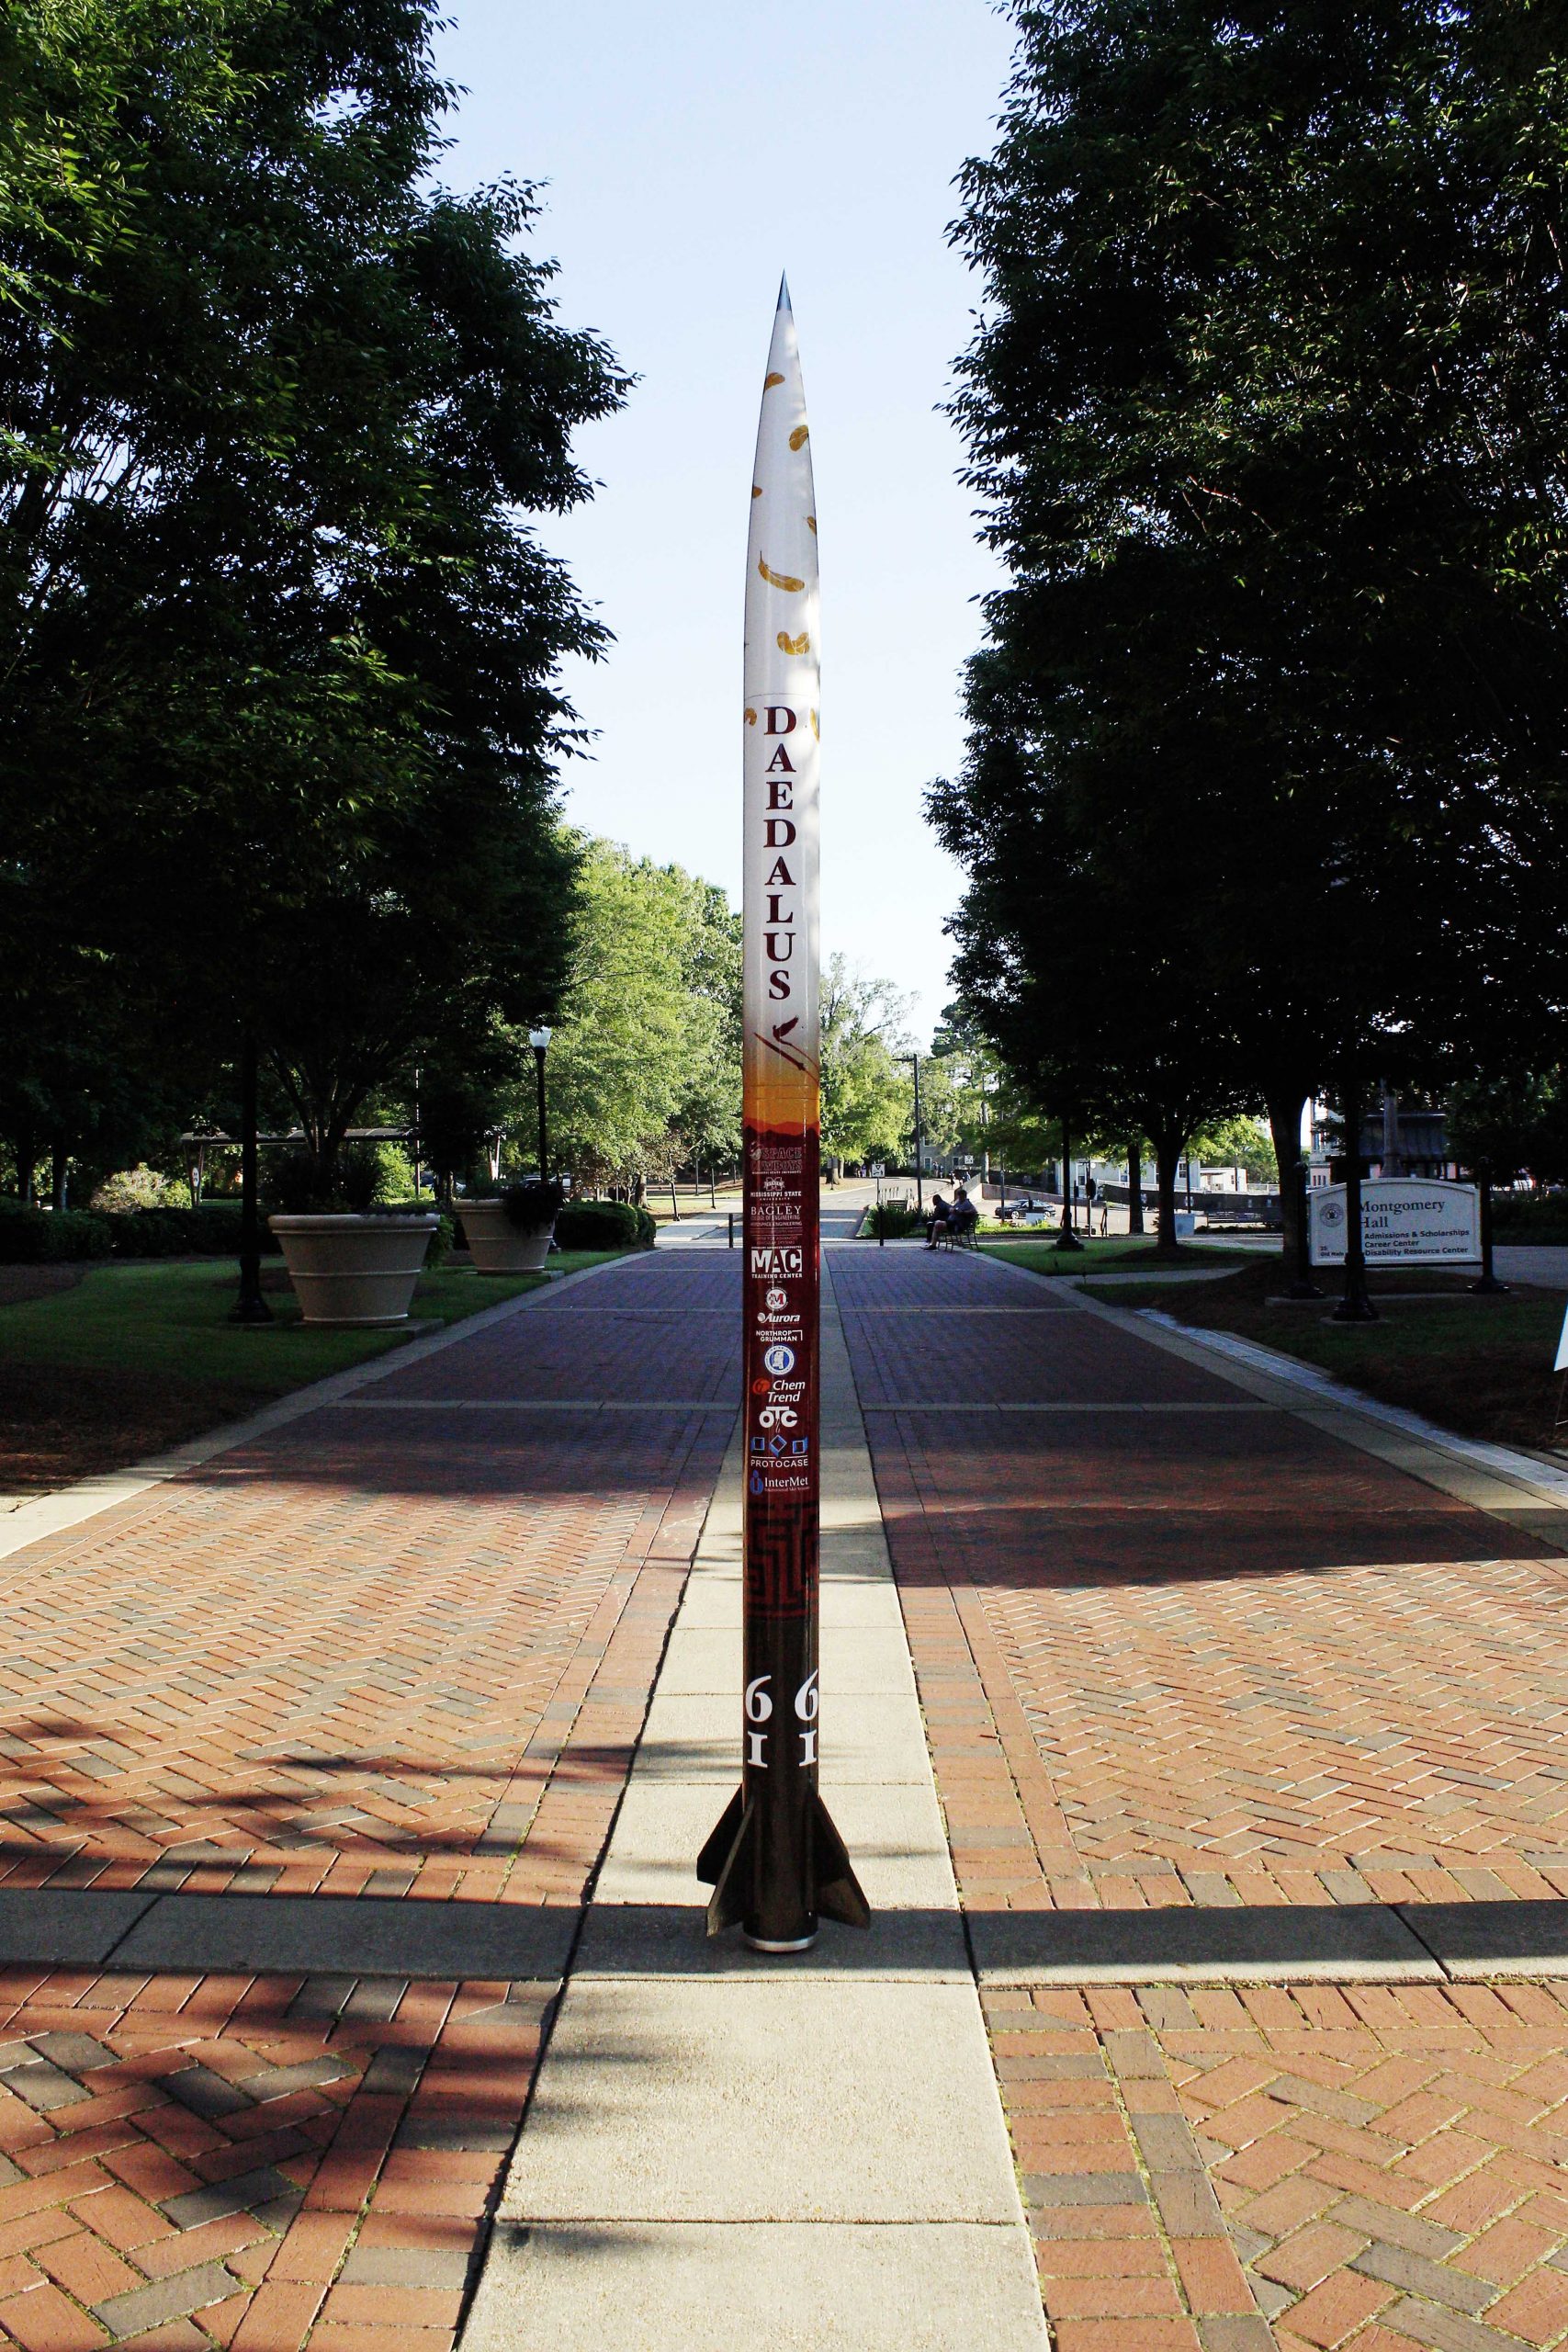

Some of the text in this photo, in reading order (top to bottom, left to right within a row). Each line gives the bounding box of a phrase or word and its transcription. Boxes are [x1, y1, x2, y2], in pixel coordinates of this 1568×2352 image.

[763, 706, 797, 1001] DAEDALUS
[762, 1147, 803, 1159] SPACE
[750, 1205, 802, 1216] BAGLEY
[1359, 1200, 1446, 1215] Montgomery
[1359, 1216, 1389, 1228] Hall
[1364, 1231, 1409, 1239] Admissions
[1419, 1228, 1470, 1238] Scholarships
[1364, 1249, 1402, 1257] Disability
[751, 1250, 803, 1273] MAC
[763, 1312, 801, 1323] Aurora
[773, 1379, 806, 1390] Chem
[768, 1390, 801, 1403] Trend
[750, 1458, 808, 1468] PROTOCASE
[764, 1476, 808, 1487] InterMet
